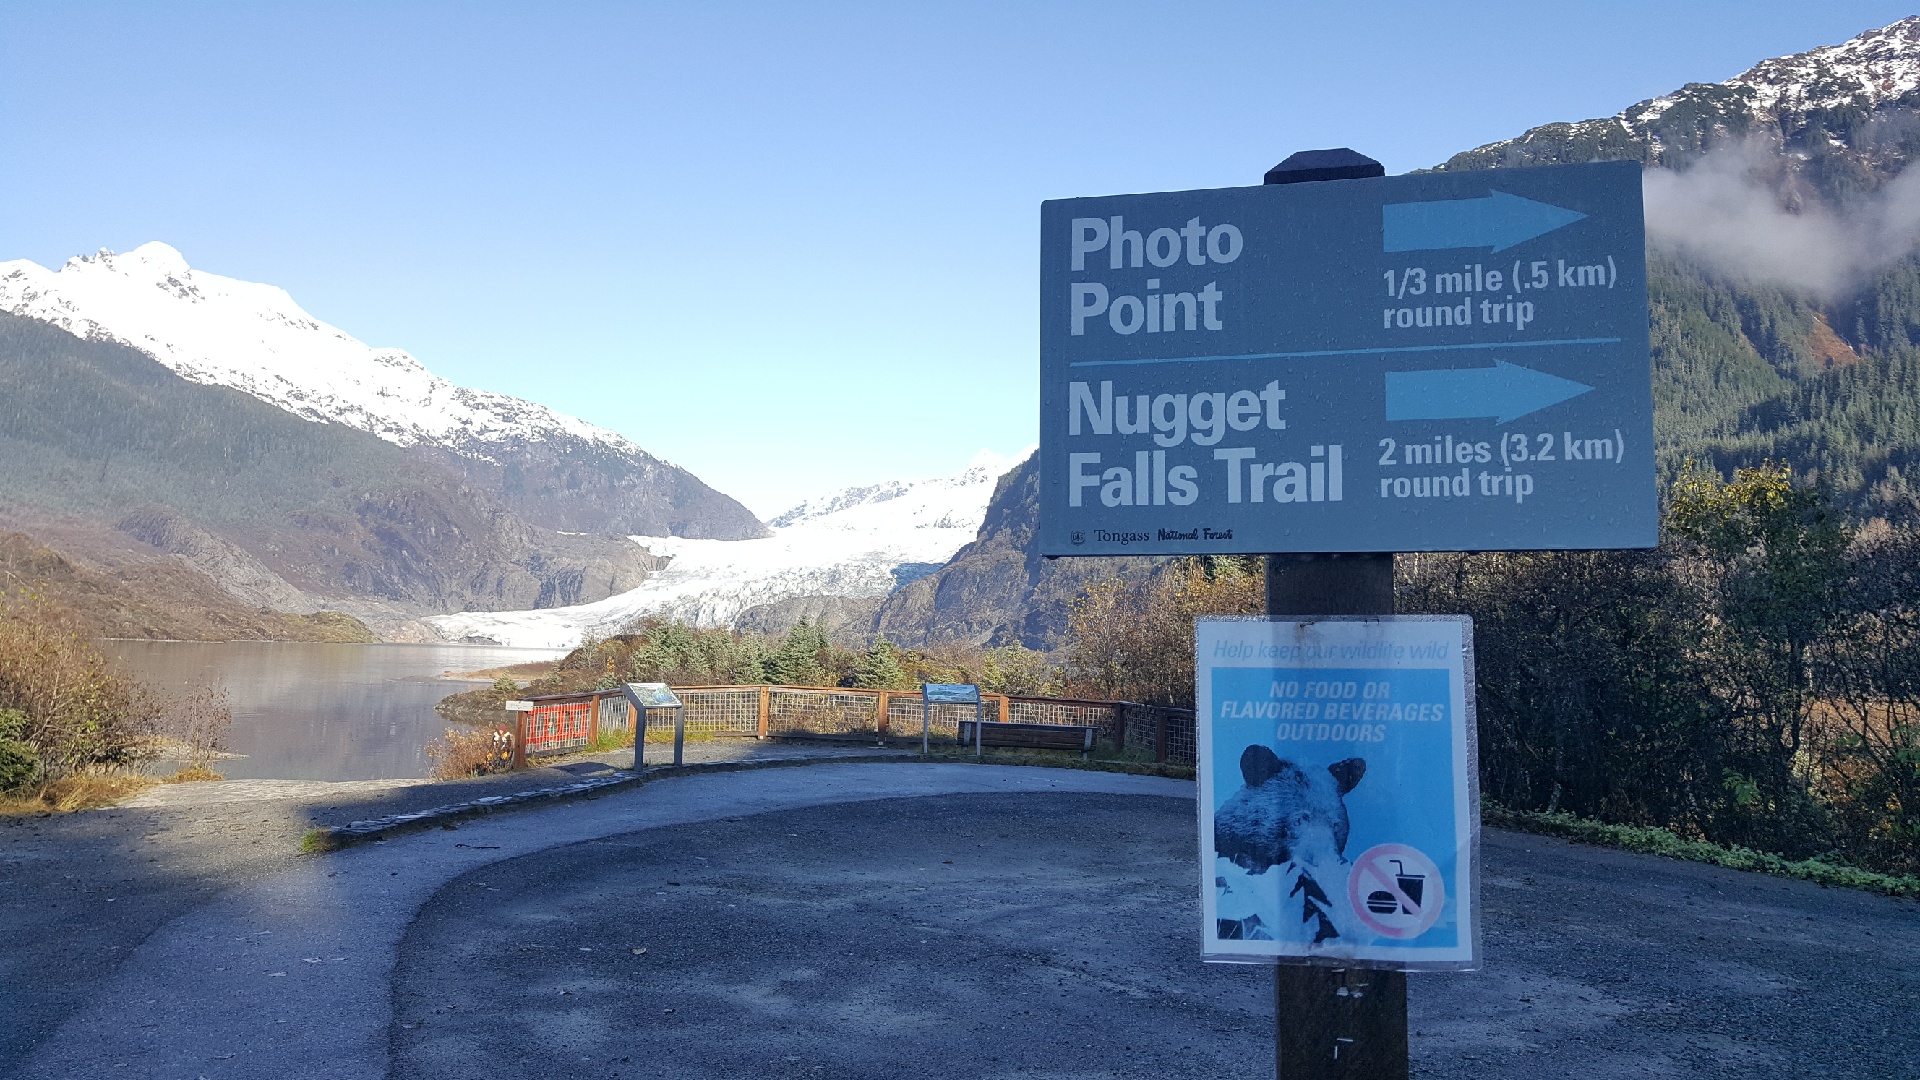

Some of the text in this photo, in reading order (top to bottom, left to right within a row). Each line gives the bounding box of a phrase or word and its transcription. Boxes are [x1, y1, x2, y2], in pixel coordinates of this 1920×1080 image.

[1071, 216, 1244, 271] Photo
[1383, 256, 1617, 298] 1/3 mile (.5 km)
[1071, 279, 1223, 335] Point
[1383, 295, 1534, 330] round trip
[1068, 380, 1286, 447] Nugget
[1379, 429, 1625, 466] 2 miles (3.2 km)
[1069, 445, 1343, 507] Falls Trail
[1380, 465, 1533, 502] round trip
[1094, 528, 1233, 545] Tongass National Forest
[1213, 640, 1252, 661] Help
[1258, 640, 1300, 661] keep
[1410, 641, 1449, 660] wild
[1269, 681, 1390, 699] NO FOOD OR
[1220, 701, 1445, 722] FLAVORED BEVERAGES
[1276, 723, 1387, 743] OUTDOORS
